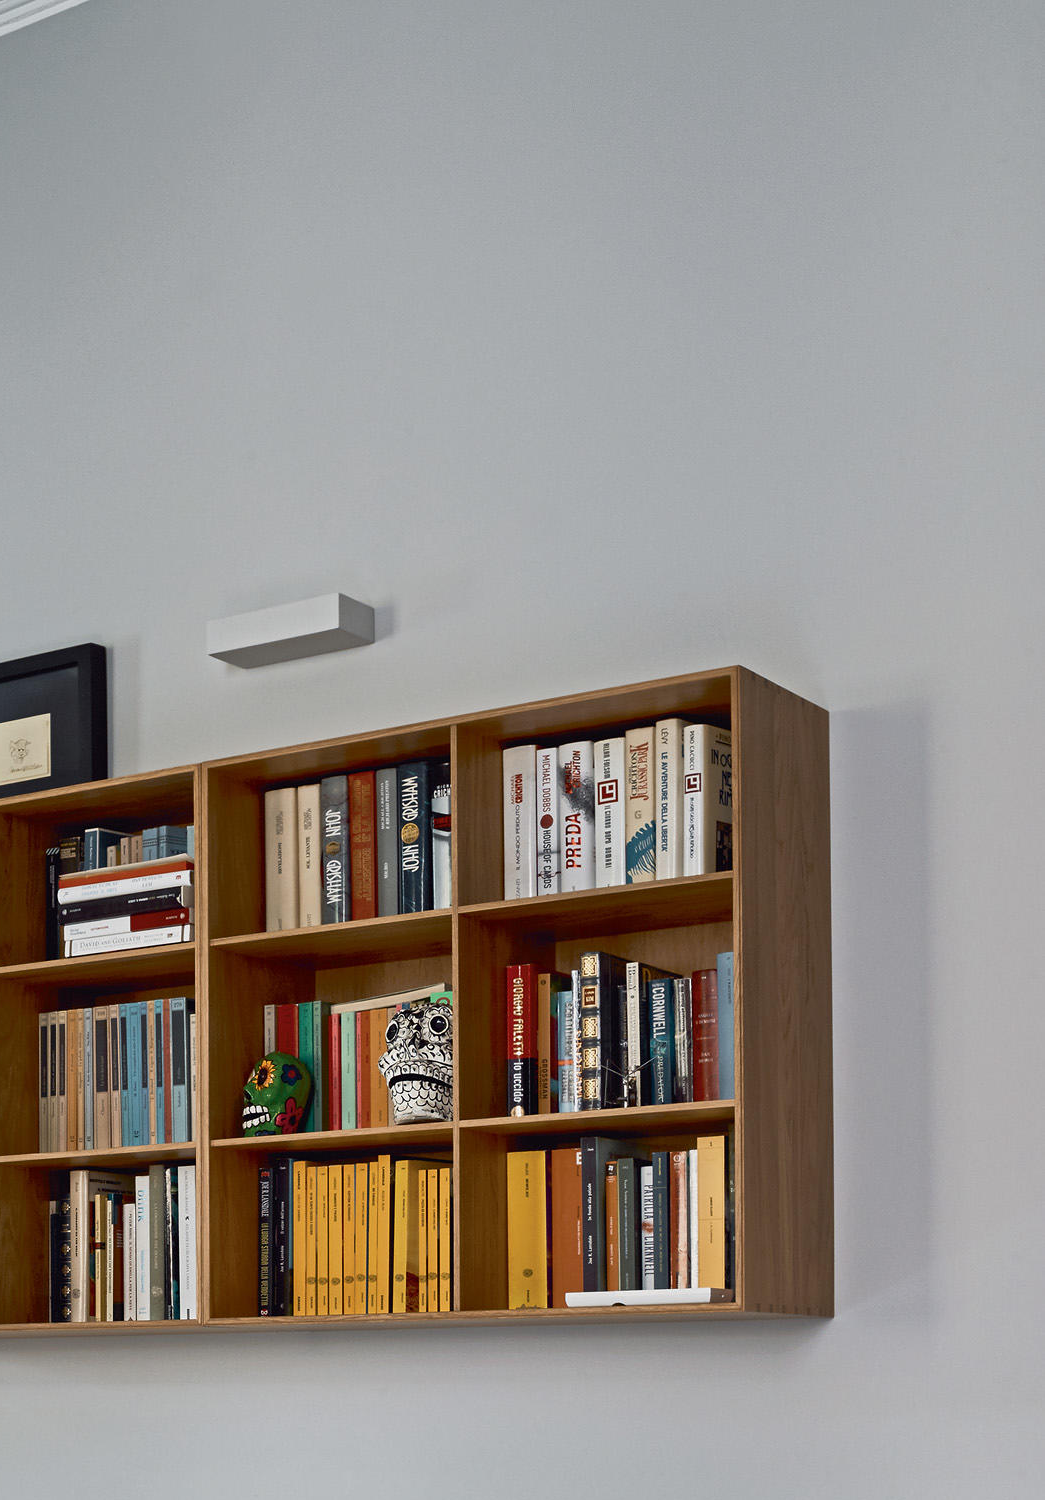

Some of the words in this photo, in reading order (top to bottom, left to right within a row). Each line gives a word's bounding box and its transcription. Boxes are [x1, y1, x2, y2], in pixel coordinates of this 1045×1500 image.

[542, 755, 550, 786] MICHAEL
[572, 750, 581, 788] CRICHTON
[711, 749, 719, 765] IN
[515, 774, 523, 804] CRICHTON
[565, 761, 573, 794] MICHAEL
[402, 776, 418, 821] GRISHAM
[543, 788, 551, 812] DOBBS
[325, 809, 341, 837] JOHN
[565, 813, 581, 869] PREDA
[402, 844, 419, 873] JOHN
[543, 854, 551, 863] OF
[326, 859, 342, 904] GRISHAM
[544, 865, 552, 889] CARDS
[80, 941, 99, 949] DAVID
[112, 935, 141, 944] GOLIATH
[652, 987, 666, 1039] CORNWELL
[513, 1072, 524, 1103] uccido
[261, 1194, 269, 1217] LANSDALE
[644, 1184, 653, 1220] PATRICIA
